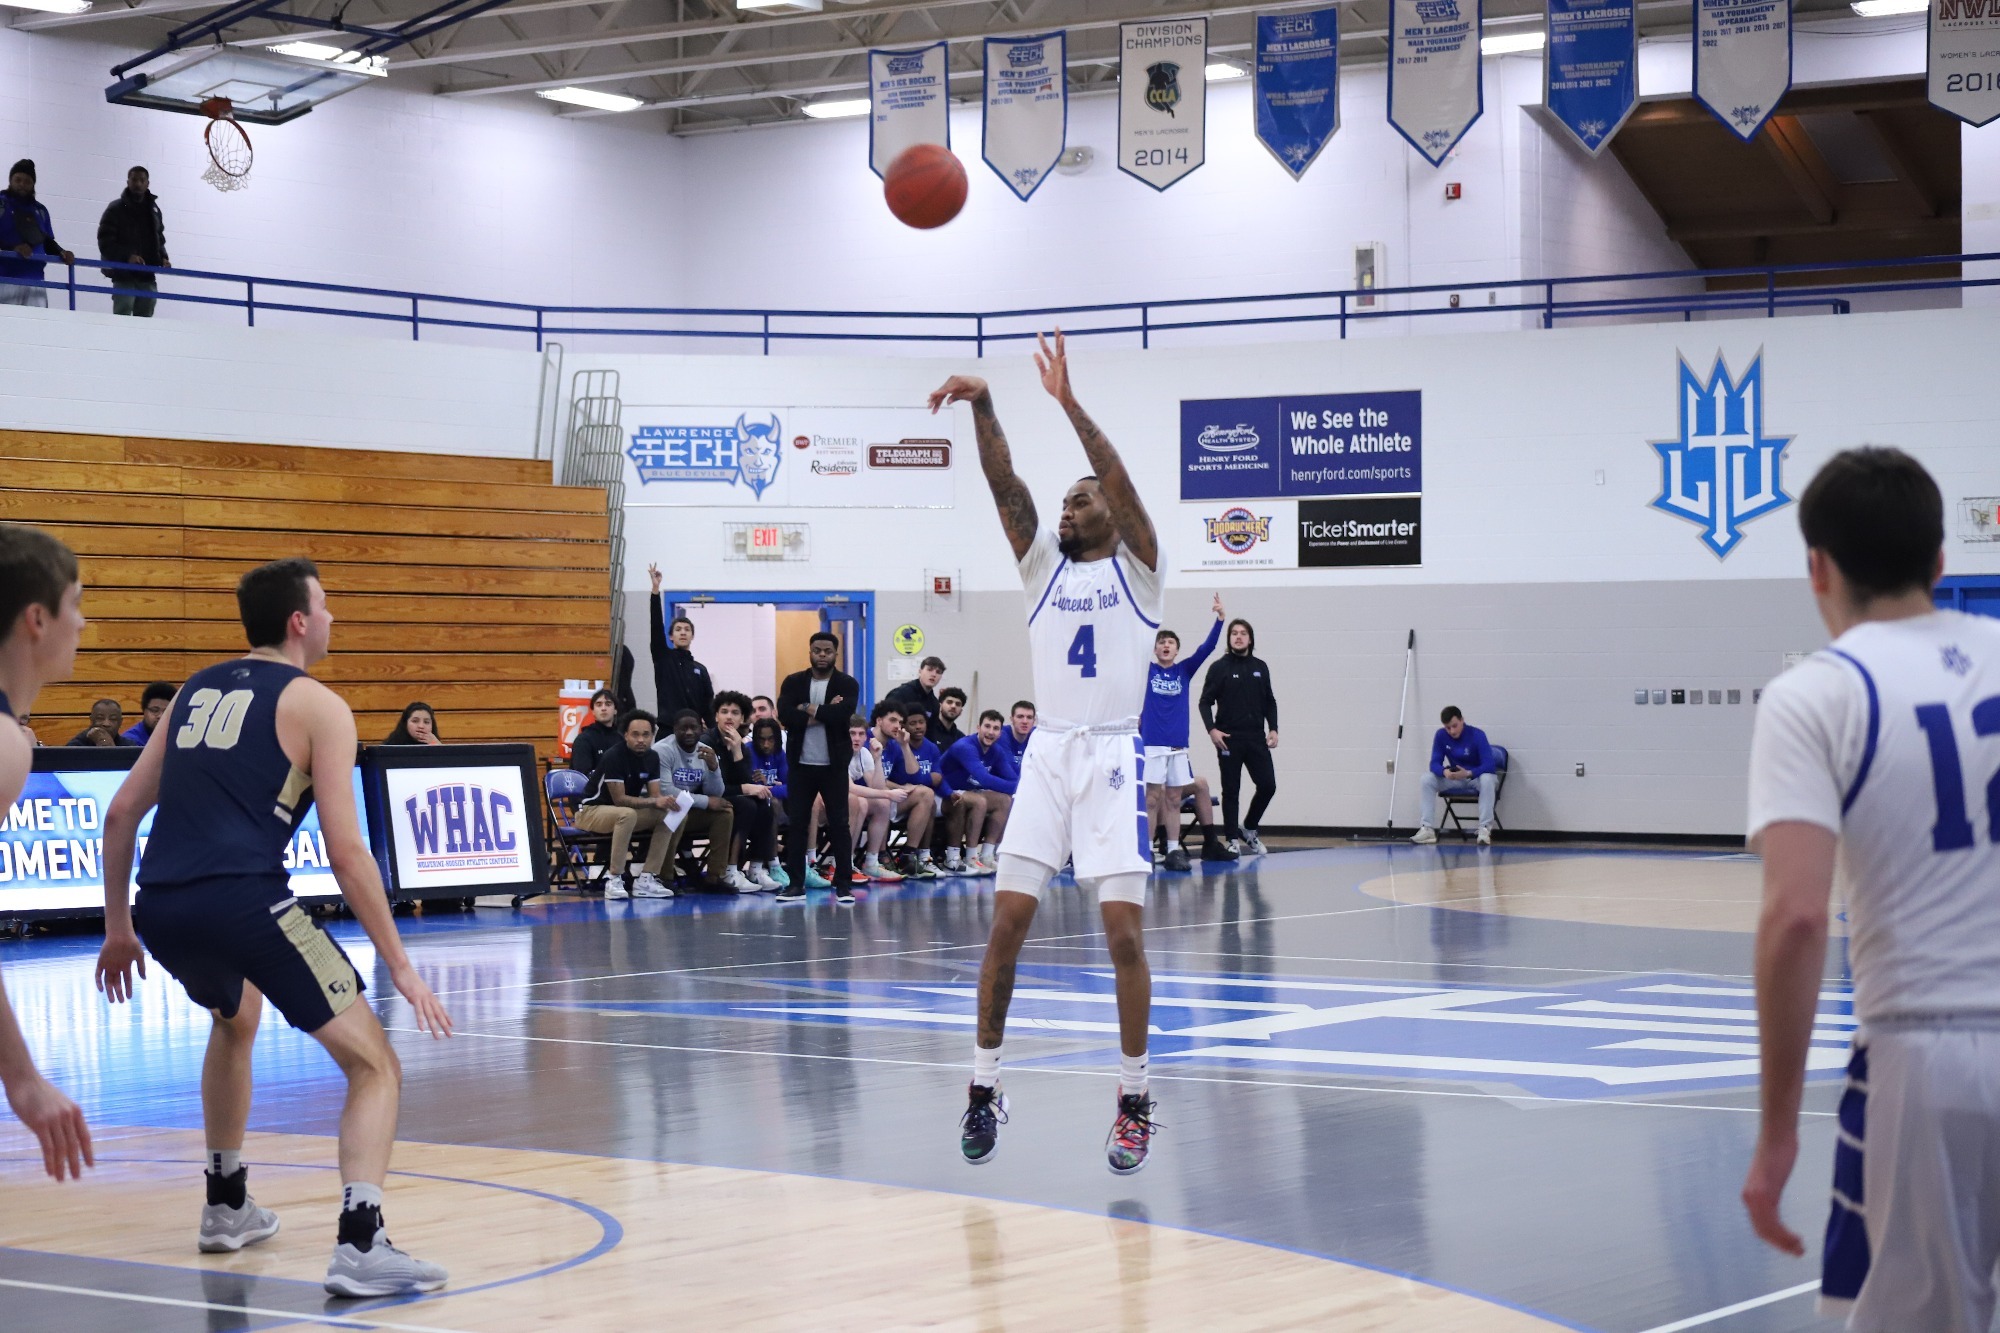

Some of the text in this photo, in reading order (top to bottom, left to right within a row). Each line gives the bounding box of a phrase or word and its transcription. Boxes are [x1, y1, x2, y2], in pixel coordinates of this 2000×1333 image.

[1418, 4, 1457, 17] TECH
[1551, 8, 1631, 21] WOMEN'S LACROSSE
[1727, 5, 1775, 17] TOURNAMENT
[1137, 24, 1192, 37] DIVISION
[1275, 19, 1313, 32] TECH
[1405, 22, 1470, 36] MEN'S LACROSSE
[1126, 35, 1202, 49] CHAMPIONS
[1289, 38, 1331, 51] LACROSSE
[1008, 49, 1042, 62] TECH
[1940, 51, 1976, 59] WOMEN'S
[1000, 70, 1023, 78] MEN'S
[1947, 73, 2000, 92] 201
[1150, 89, 1176, 103] CCLA
[1135, 148, 1188, 166] 2014
[1291, 408, 1388, 430] We See the
[643, 428, 734, 437] LAWRENCE
[813, 435, 858, 446] PREMIER
[1291, 432, 1412, 455] Whole Athlete
[631, 438, 739, 467] TECH
[876, 449, 931, 458] TELEGRAPH
[1199, 454, 1259, 463] HENRY FORD
[811, 459, 858, 474] Residency
[891, 457, 944, 465] SMOKEHOUSE
[1188, 462, 1269, 471] SPORTS MEDICINE
[1291, 466, 1411, 483] henryford.com/sports
[1207, 517, 1269, 543] FUDDRUCKERS
[1301, 519, 1416, 538] TicketSmarter
[754, 528, 777, 546] EXIT
[1097, 585, 1120, 610] Tech
[1067, 624, 1096, 678] 4
[176, 688, 254, 750] 30
[563, 708, 577, 726] G
[59, 797, 98, 831] TO
[404, 784, 517, 856] WHAC
[0, 838, 103, 882] OMEN'
